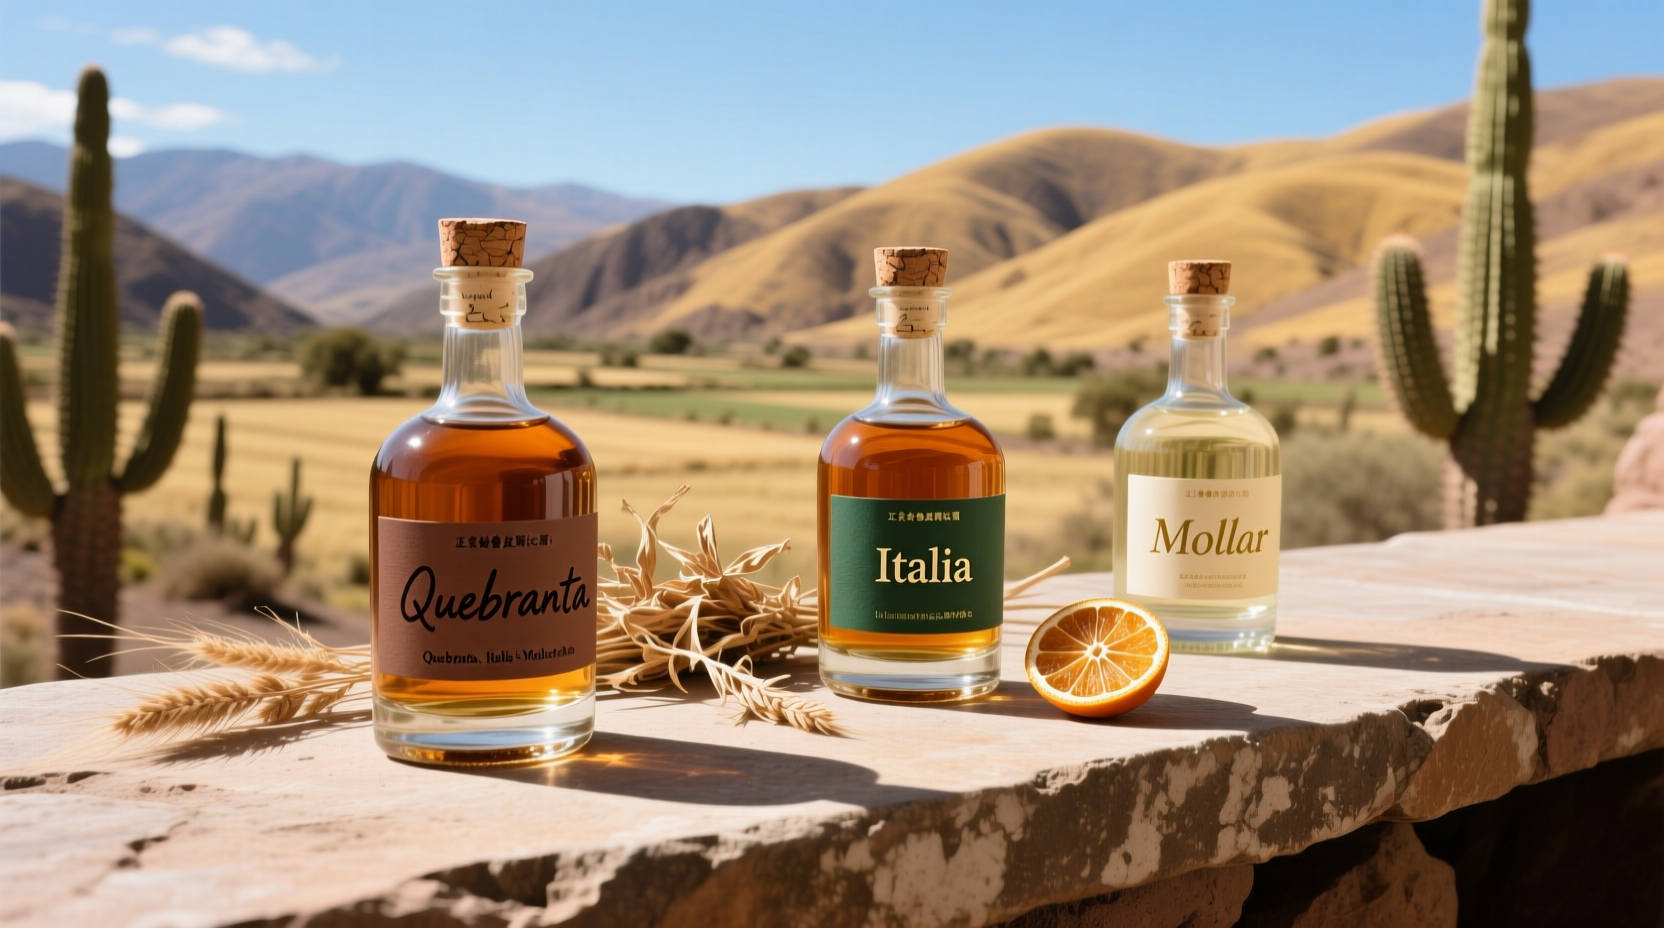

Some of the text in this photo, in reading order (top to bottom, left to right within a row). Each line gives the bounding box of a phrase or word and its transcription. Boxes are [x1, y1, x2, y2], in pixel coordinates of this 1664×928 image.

[1149, 517, 1269, 556] Mollar
[875, 546, 973, 583] Italia
[401, 565, 590, 632] Quebranta
